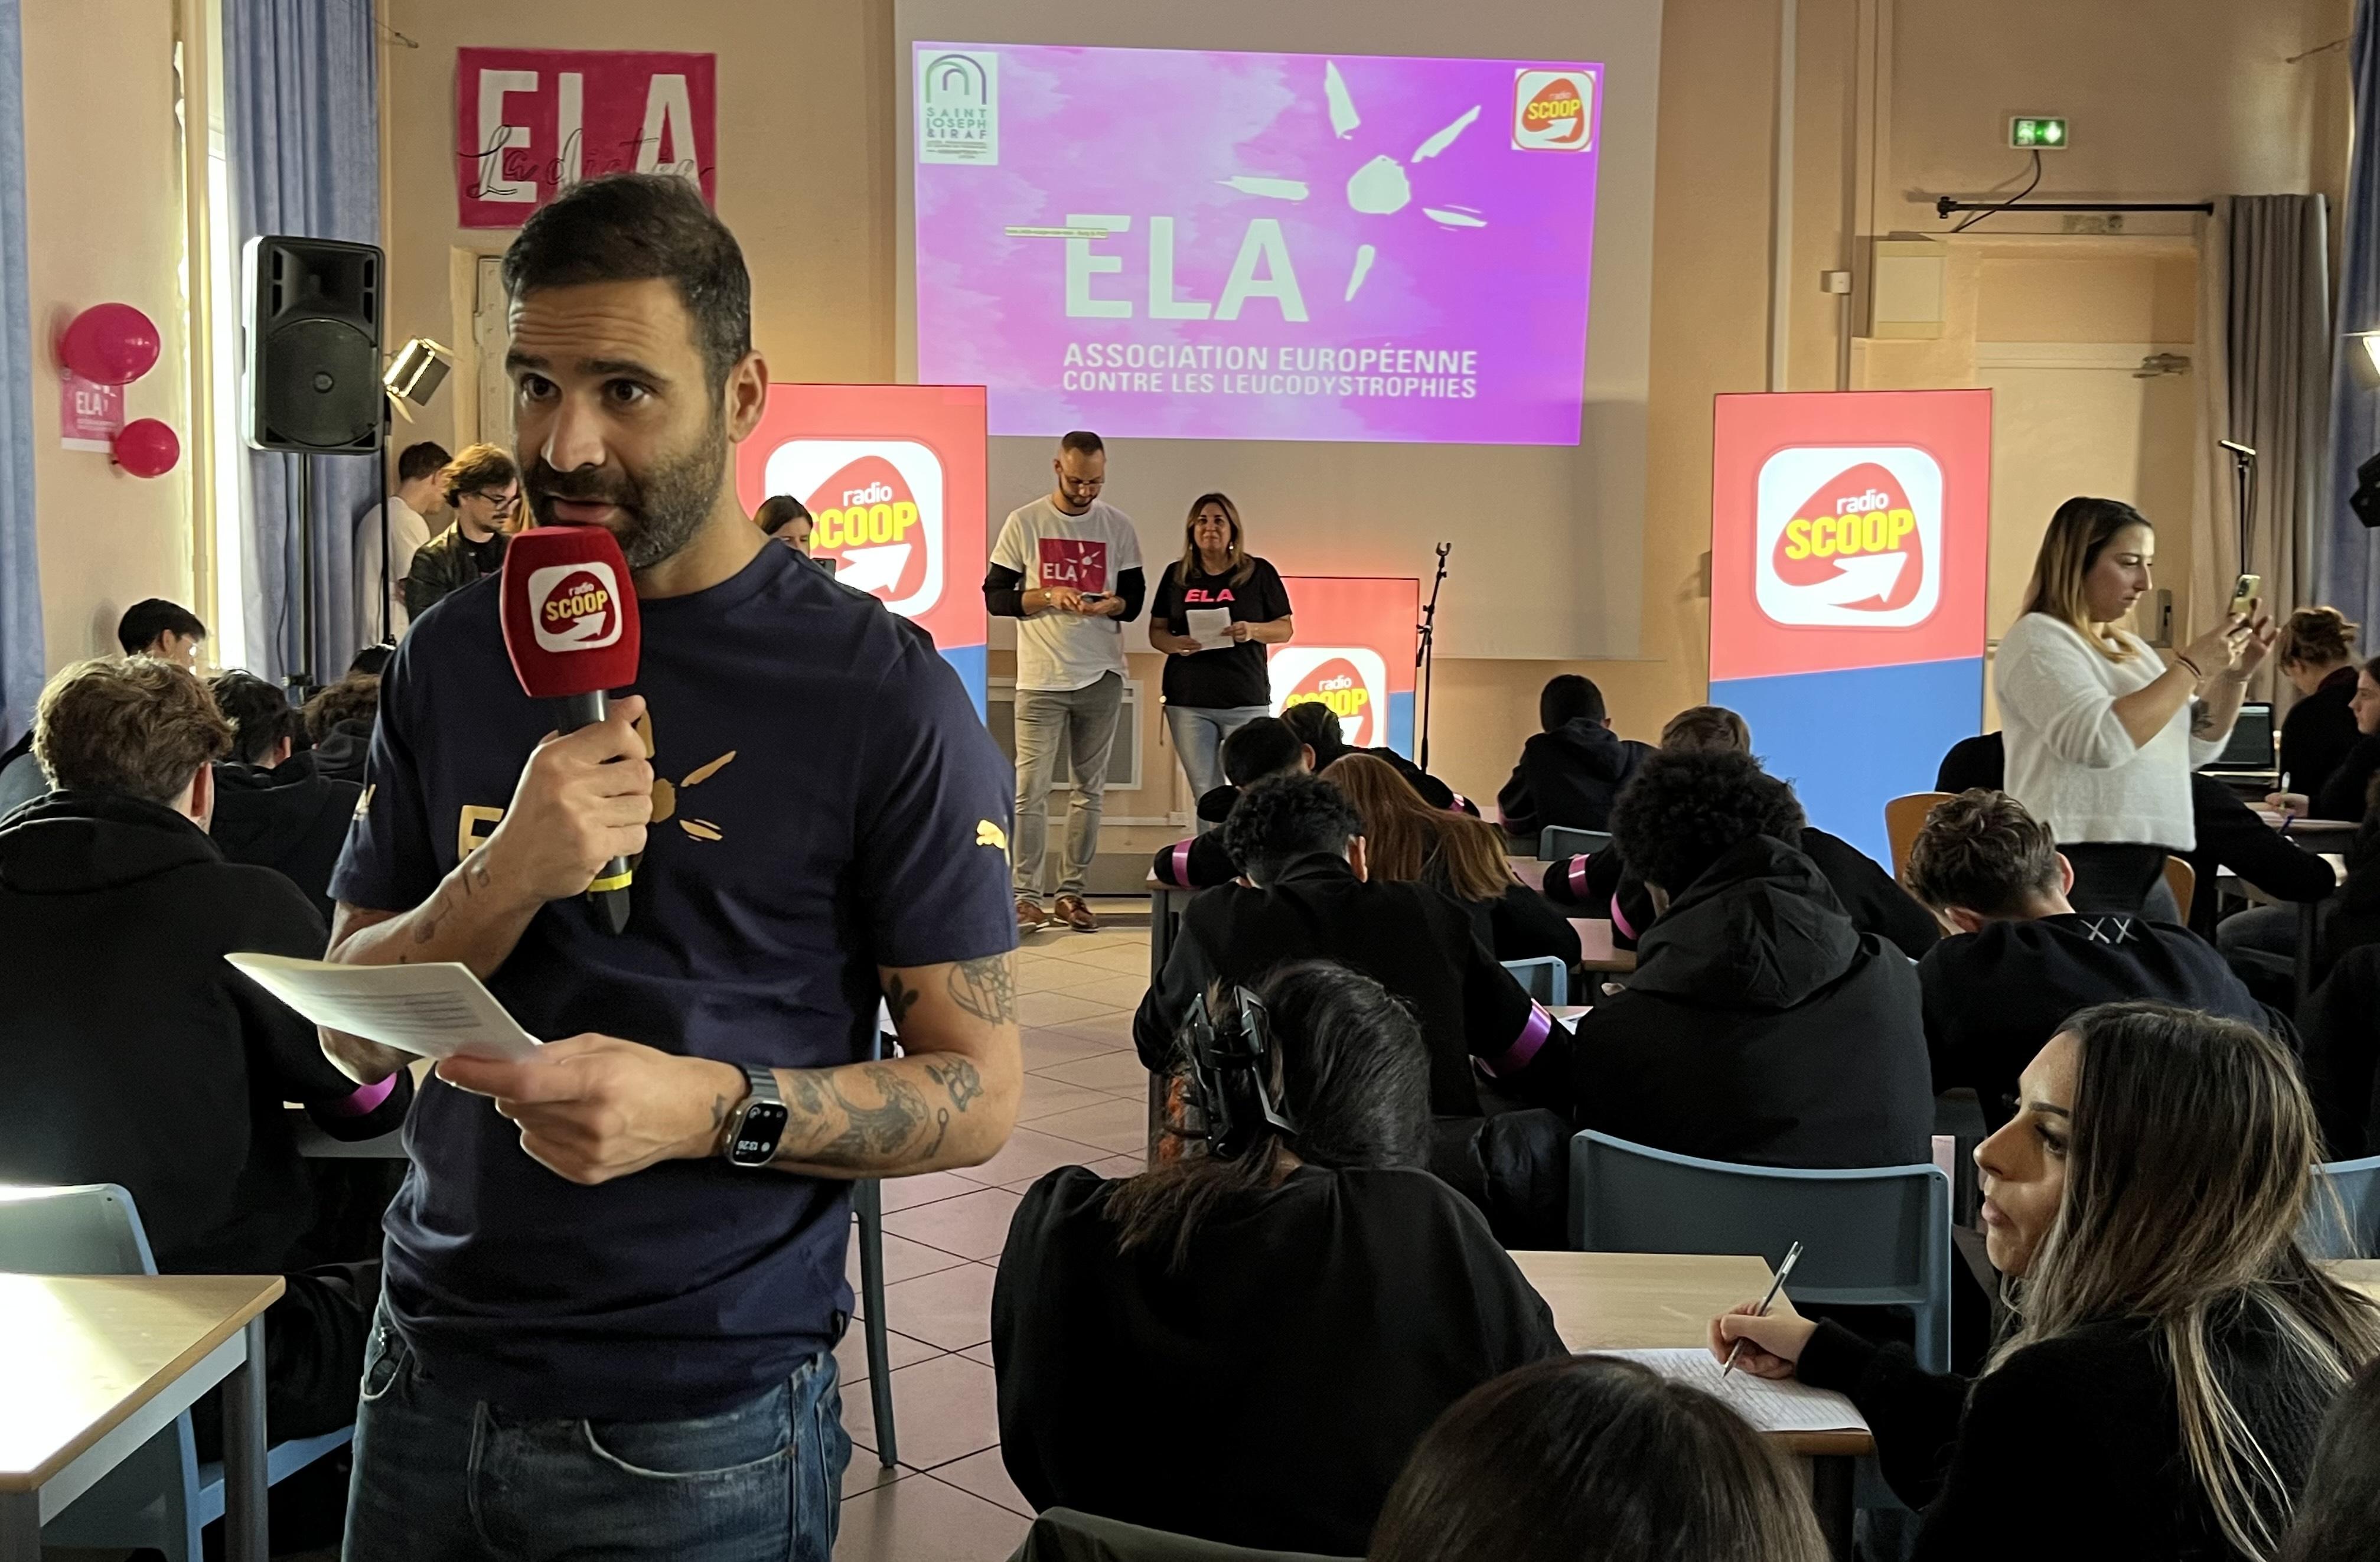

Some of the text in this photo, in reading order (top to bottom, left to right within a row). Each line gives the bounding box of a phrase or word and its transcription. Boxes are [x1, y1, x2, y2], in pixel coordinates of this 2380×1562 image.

[926, 107, 987, 118] SAINT
[1527, 99, 1581, 120] SCOOP
[1065, 214, 1309, 322] ELA
[1063, 342, 1478, 375] ASSOCIATION EUROPÉENNE
[1063, 370, 1476, 399] CONTRE LES LEUCODYSTROPHIES
[76, 391, 103, 416] ELA
[843, 481, 893, 507] radio
[1836, 489, 1889, 515] radio
[1785, 508, 1915, 560] SCOOP
[1043, 563, 1078, 582] ELA
[546, 590, 608, 621] SCOOP
[1185, 589, 1235, 602] ELA
[1318, 674, 1352, 692] radio
